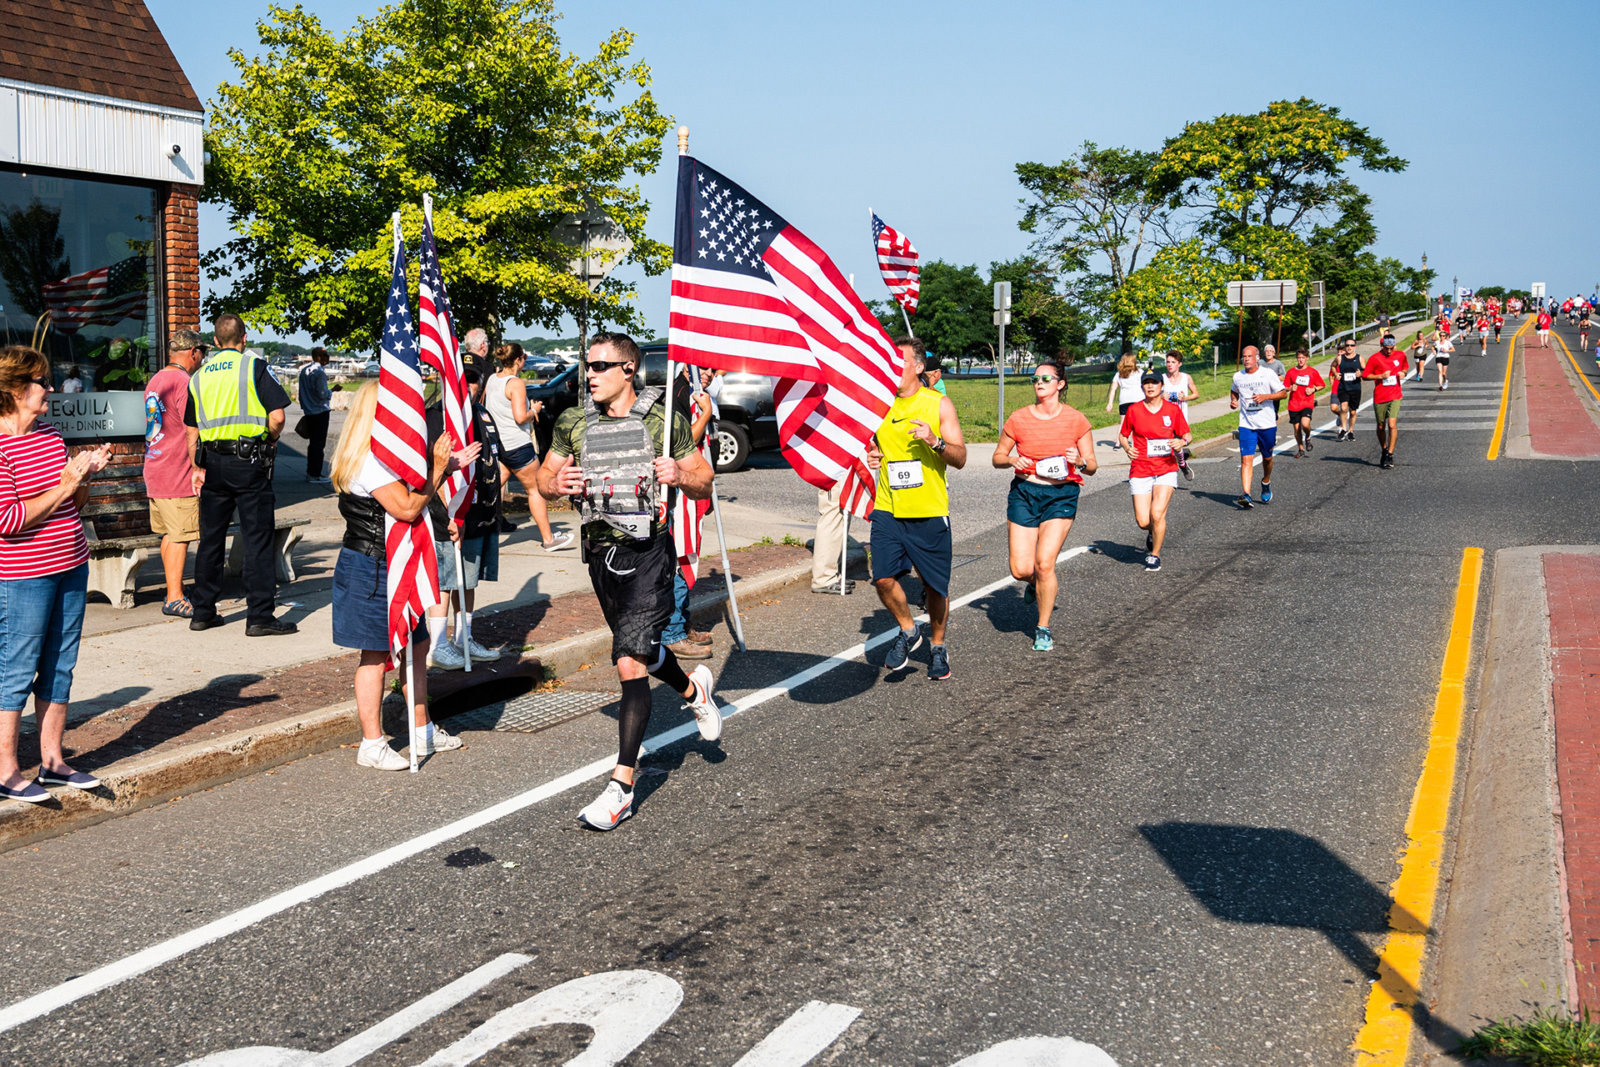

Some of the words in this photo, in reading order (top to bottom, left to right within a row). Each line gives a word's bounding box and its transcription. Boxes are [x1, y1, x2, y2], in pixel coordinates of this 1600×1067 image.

[204, 361, 233, 373] POLICE
[76, 419, 114, 431] DINNER
[1047, 465, 1060, 473] 45
[897, 471, 911, 480] 69
